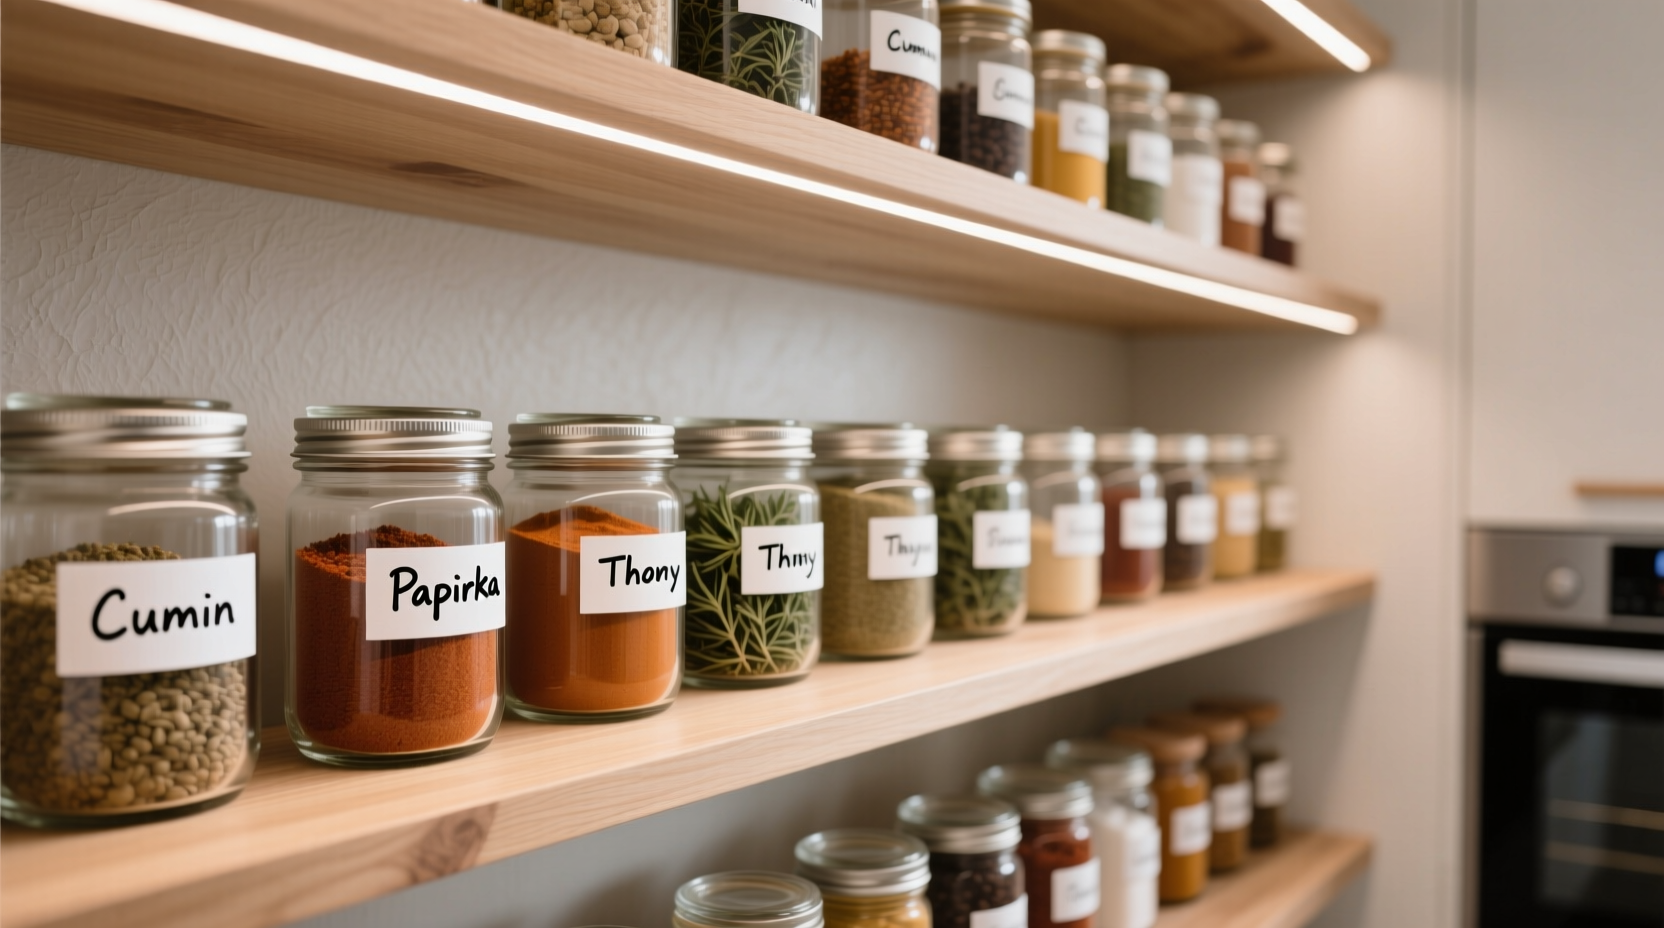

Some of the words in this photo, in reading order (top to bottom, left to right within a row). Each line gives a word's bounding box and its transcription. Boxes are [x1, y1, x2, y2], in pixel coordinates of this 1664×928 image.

[389, 565, 500, 621] Papirka
[598, 554, 680, 593] Thony
[92, 588, 234, 640] Cumin
